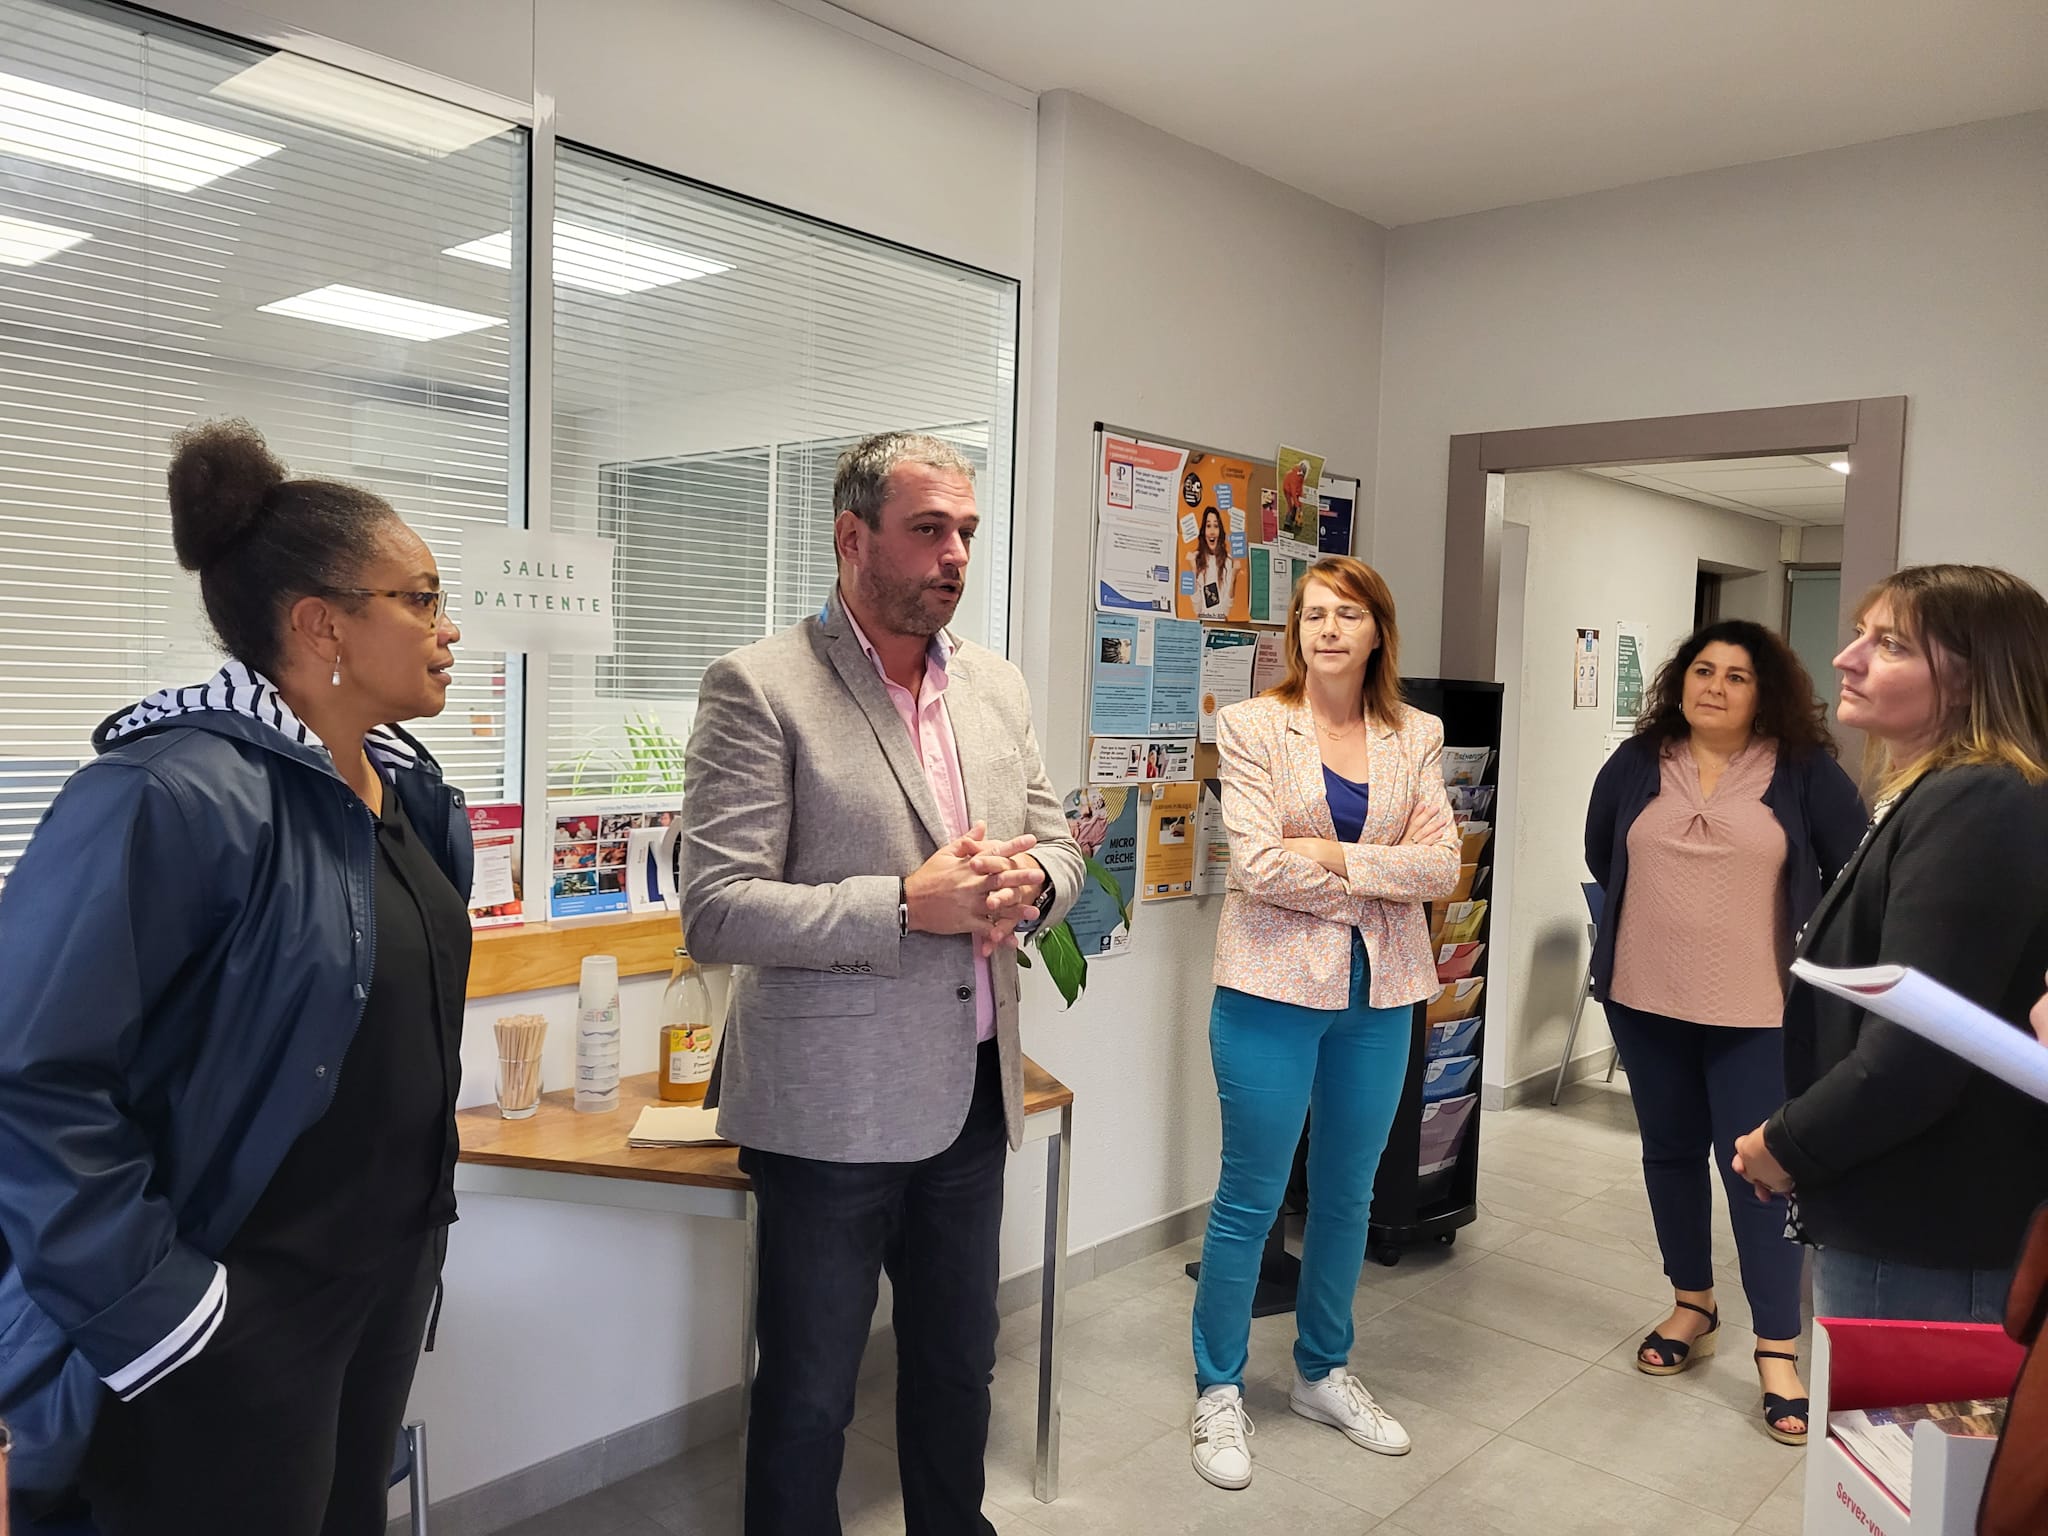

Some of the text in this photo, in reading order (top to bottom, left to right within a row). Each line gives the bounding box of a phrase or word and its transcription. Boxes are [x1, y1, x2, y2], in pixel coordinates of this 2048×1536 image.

[503, 560, 574, 579] SALLE
[474, 590, 600, 612] D'ATTENTE
[1110, 837, 1135, 848] MICRO
